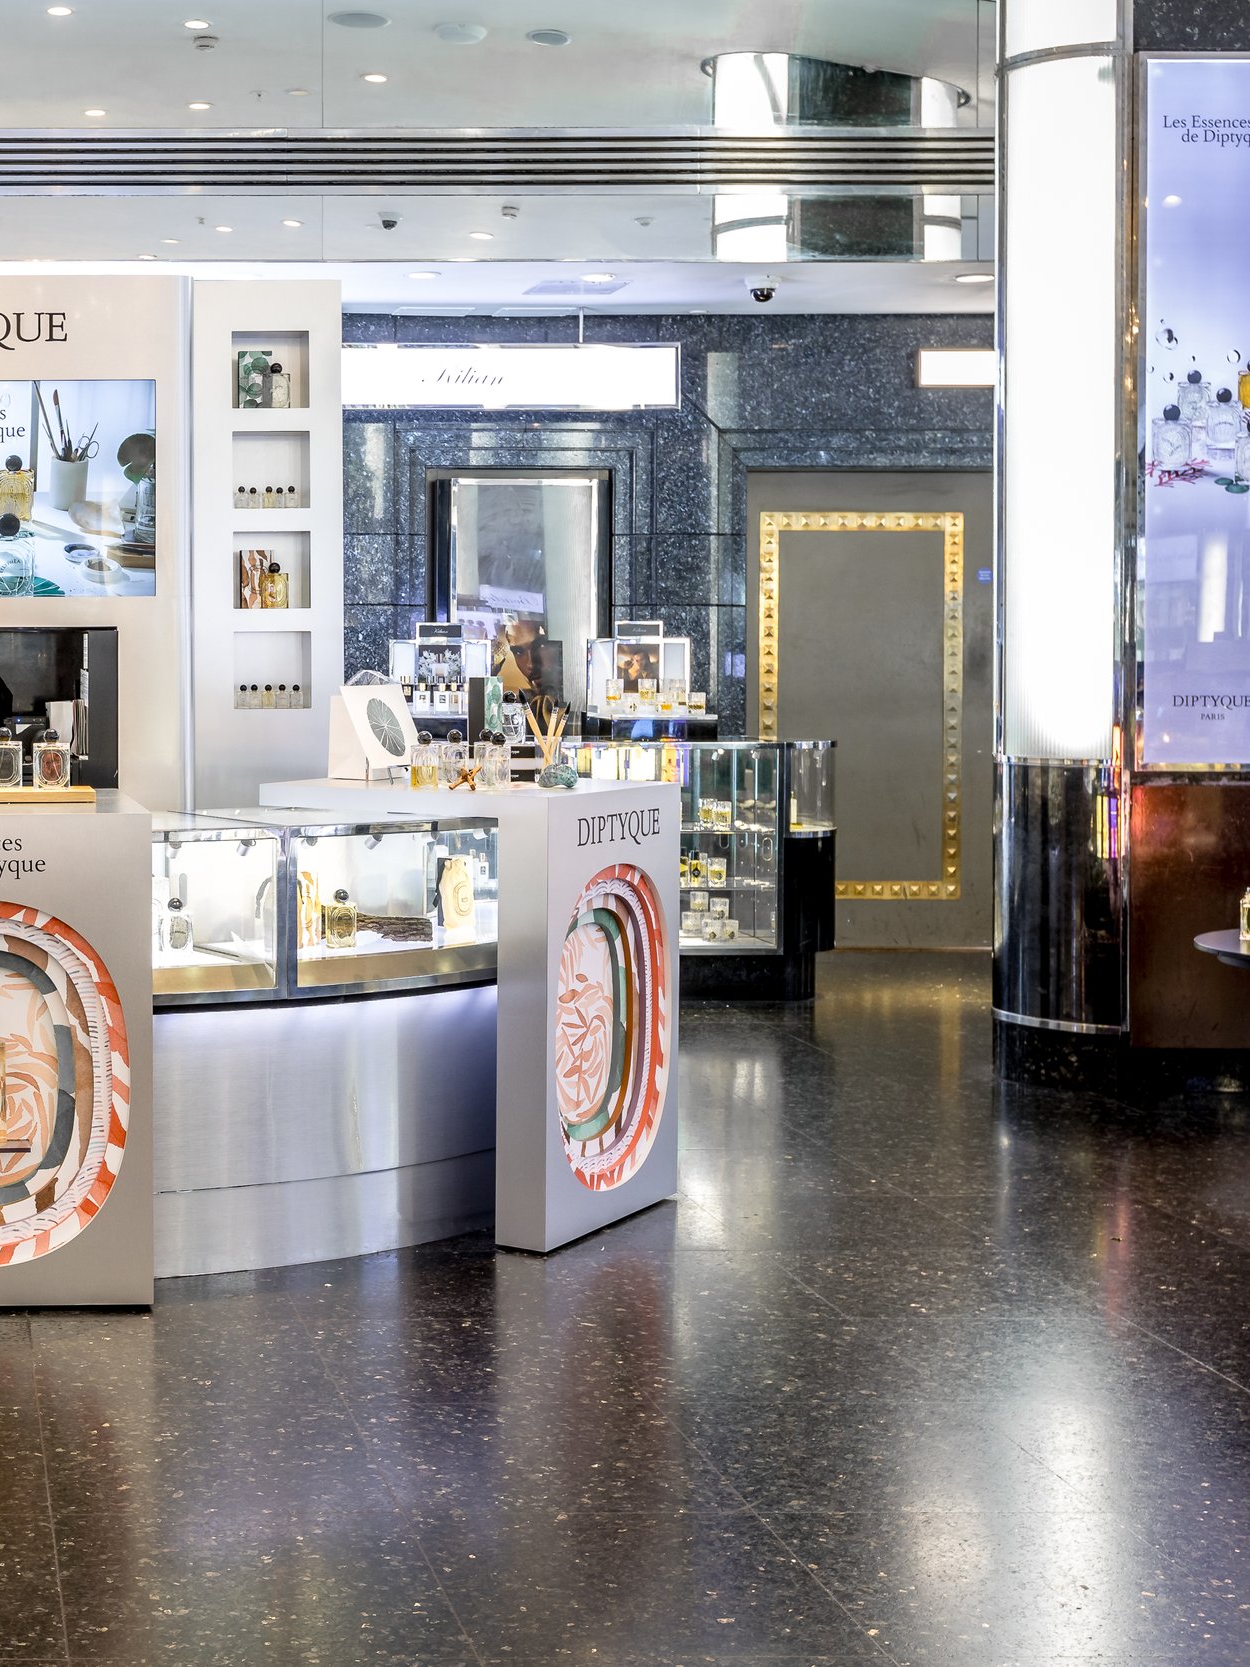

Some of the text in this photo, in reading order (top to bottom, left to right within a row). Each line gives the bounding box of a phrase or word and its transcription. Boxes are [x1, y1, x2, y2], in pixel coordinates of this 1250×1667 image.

[1163, 115, 1187, 128] Les
[1181, 129, 1198, 142] de
[1172, 694, 1250, 710] DIPTYQUE
[1200, 713, 1225, 721] PARIS
[577, 808, 661, 847] DIPTYQUE
